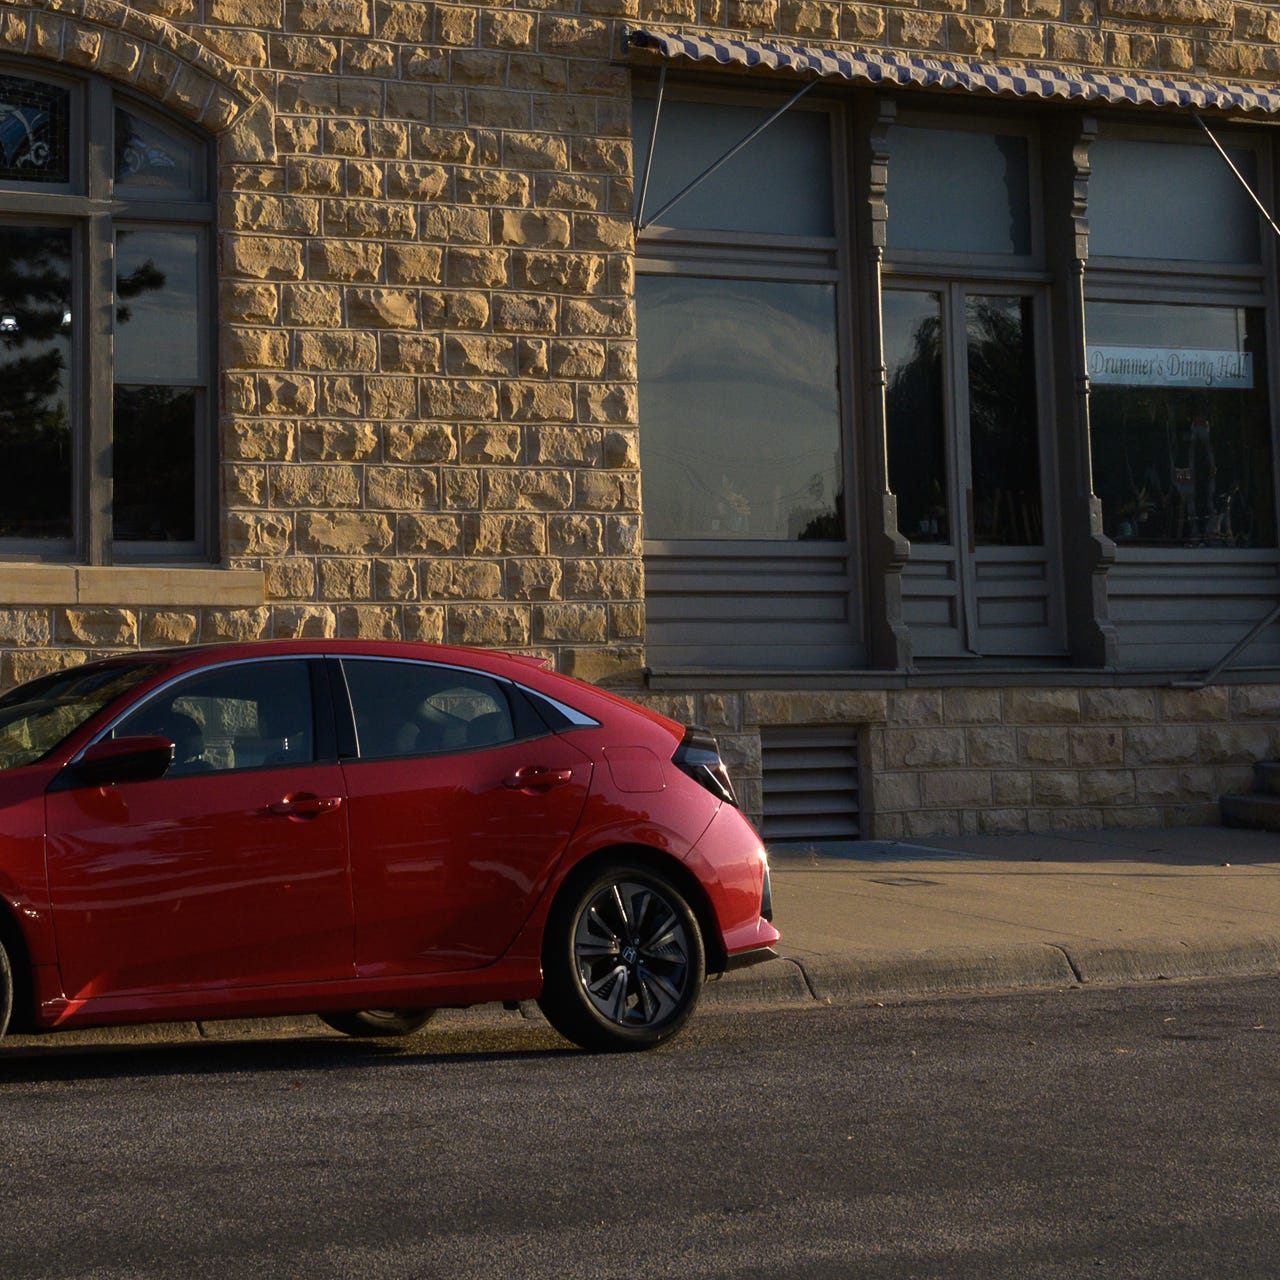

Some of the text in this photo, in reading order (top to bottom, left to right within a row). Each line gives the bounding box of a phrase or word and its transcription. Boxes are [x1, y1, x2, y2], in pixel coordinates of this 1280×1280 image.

[1090, 350, 1248, 386] Drummer's Dining Hall
